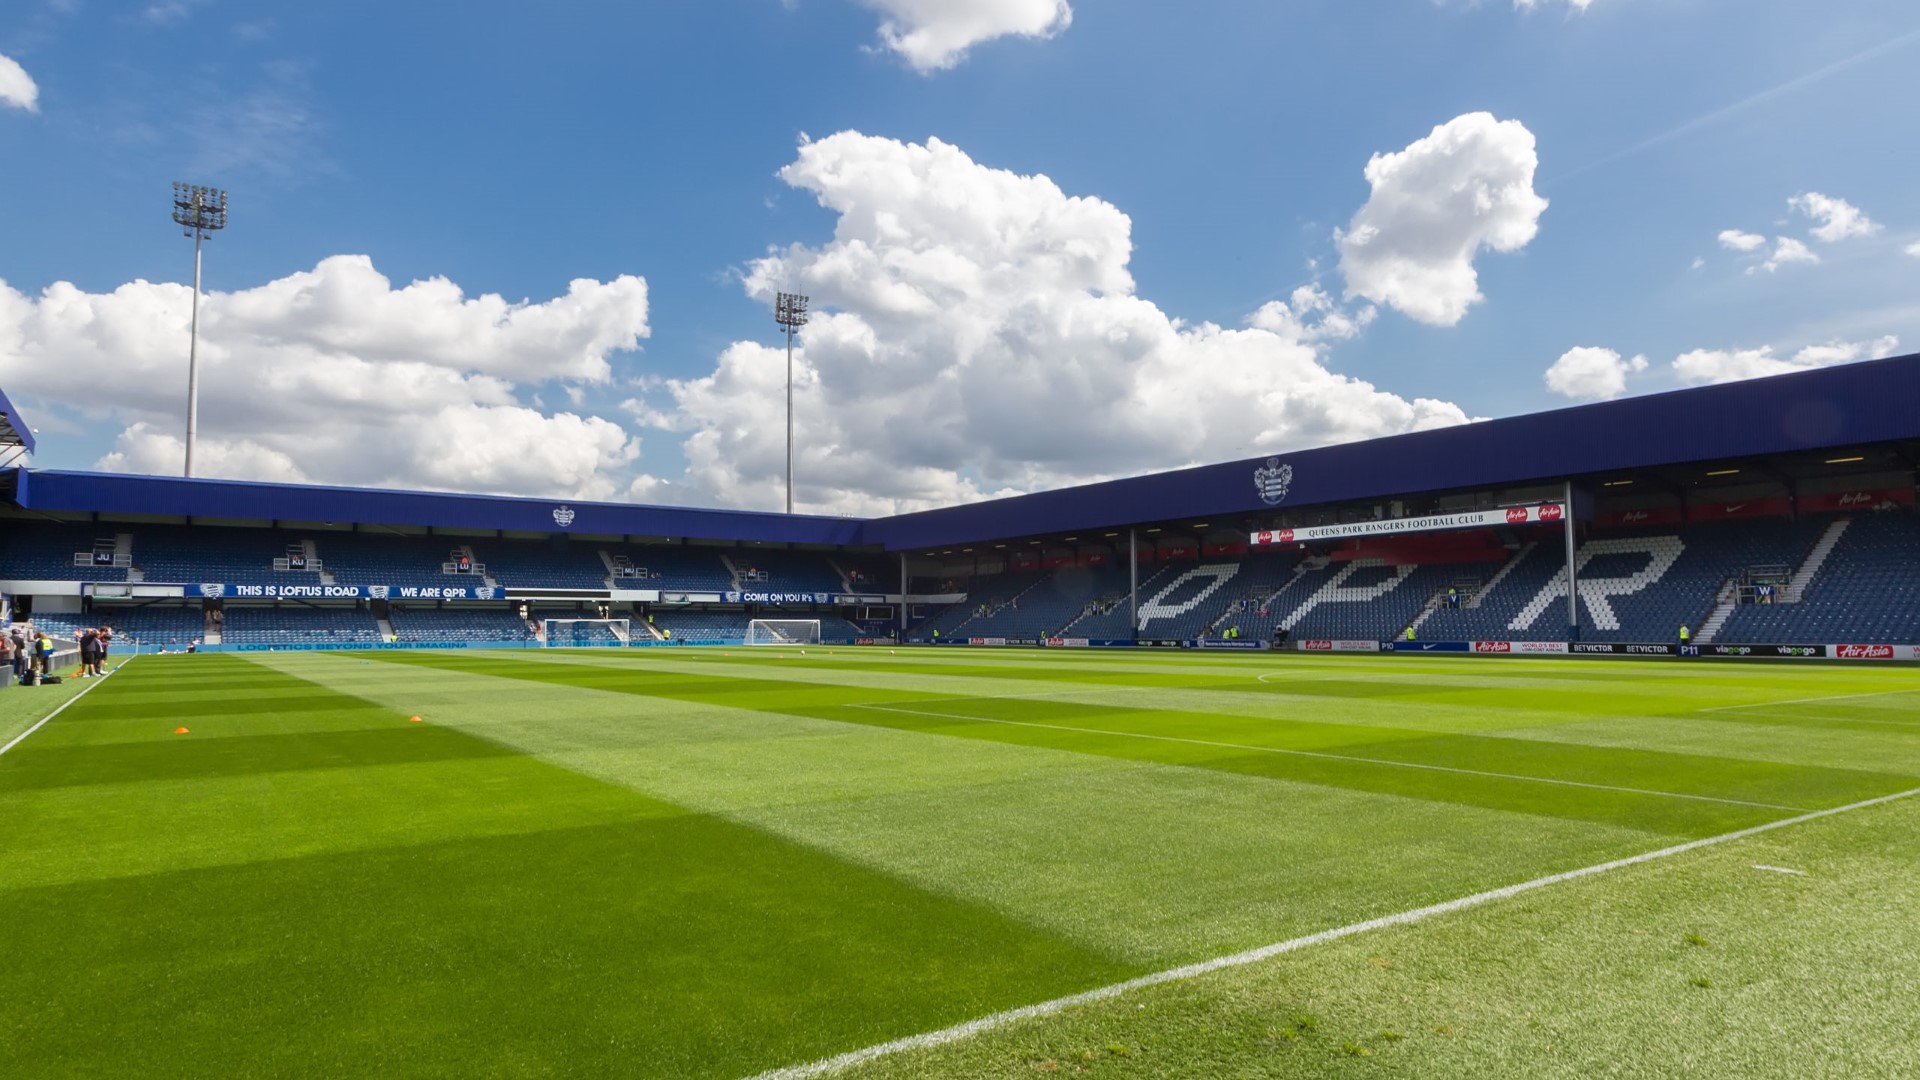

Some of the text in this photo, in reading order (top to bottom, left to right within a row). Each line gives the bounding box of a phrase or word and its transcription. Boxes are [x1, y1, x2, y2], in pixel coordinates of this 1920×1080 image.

[1308, 514, 1484, 538] QUEENS PARK RANGERS FOOTBALL CLUB
[97, 553, 110, 561] JU
[236, 585, 359, 597] THIS IS LOFTUS ROAD
[400, 587, 466, 598] WE ARE QPR
[1759, 586, 1770, 595] W
[744, 593, 813, 602] COME ON YOU R's
[237, 643, 312, 651] LOGISTICS
[1381, 642, 1394, 650] P10
[1477, 641, 1509, 652] AirAsia
[1573, 644, 1613, 652] BETVICTOR
[1626, 645, 1668, 653] BETVICTOR
[1681, 646, 1698, 655] P11
[1715, 645, 1751, 655] viagogo
[1777, 645, 1815, 656] viagogo
[1840, 645, 1891, 658] AirAsia
